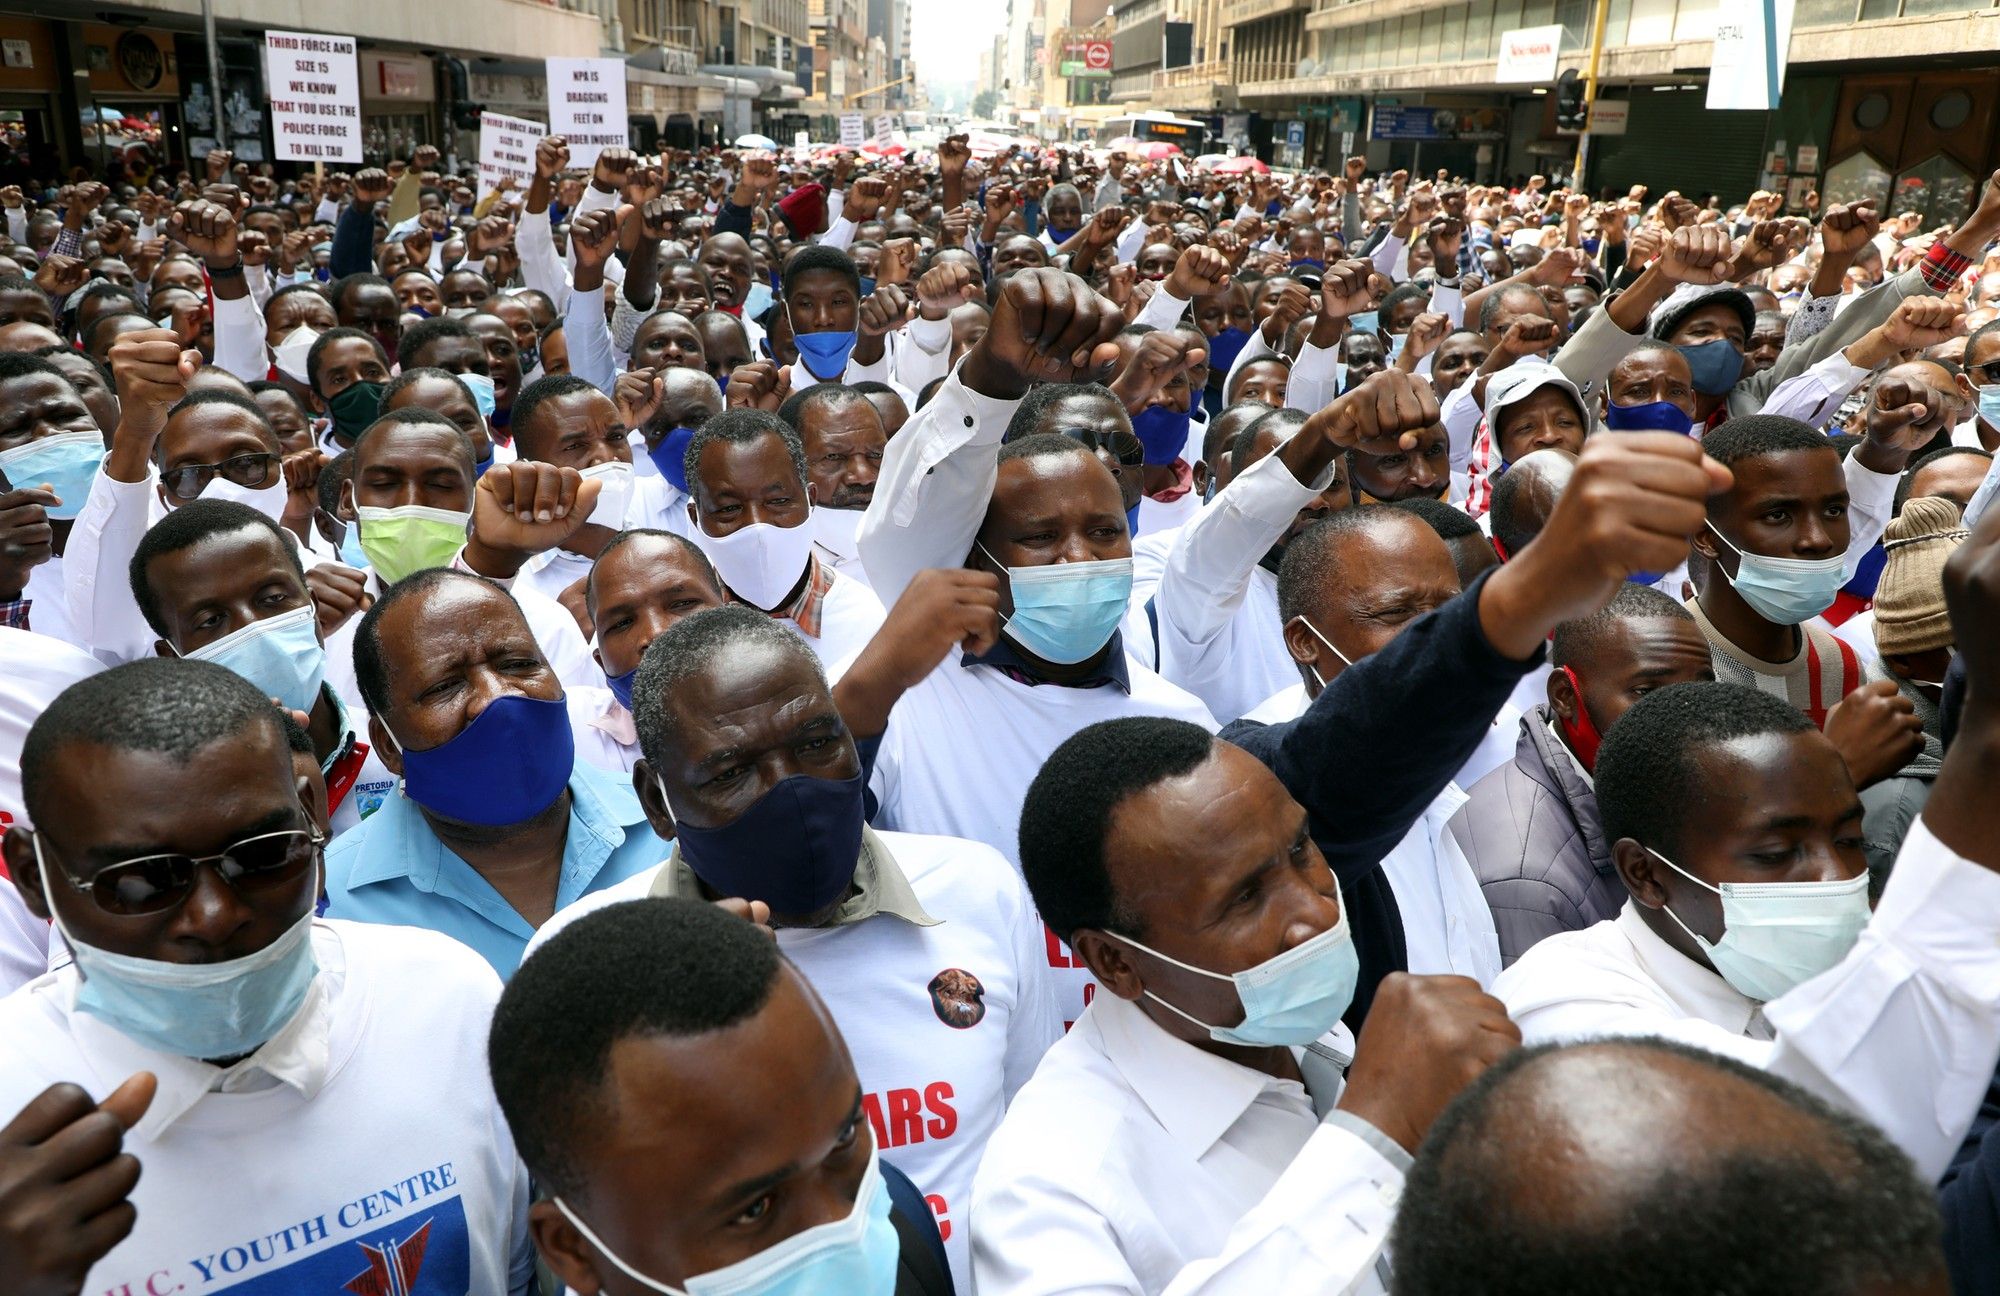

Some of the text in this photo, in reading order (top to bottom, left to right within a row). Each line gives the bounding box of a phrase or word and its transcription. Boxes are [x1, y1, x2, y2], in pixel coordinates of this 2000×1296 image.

[1718, 26, 1743, 40] RETAIL
[268, 36, 352, 54] THIRD FORCE AND
[295, 60, 329, 73] SIZE 15
[573, 71, 599, 82] NPA IS
[289, 81, 336, 94] WE KNOW
[566, 92, 608, 103] DRAGGING
[272, 101, 356, 117] THAT YOU USE THE
[573, 113, 603, 124] FEET ON
[283, 122, 347, 137] POLICE FORCE
[482, 117, 542, 136] THIRD FORCE AND
[563, 134, 624, 146] URDER INQUEST
[290, 143, 343, 157] TO KILL TAU
[506, 152, 527, 163] KNOW
[355, 781, 394, 792] PRETORIA
[190, 1215, 329, 1282] YOUTH
[338, 1162, 457, 1229] CENTRE
